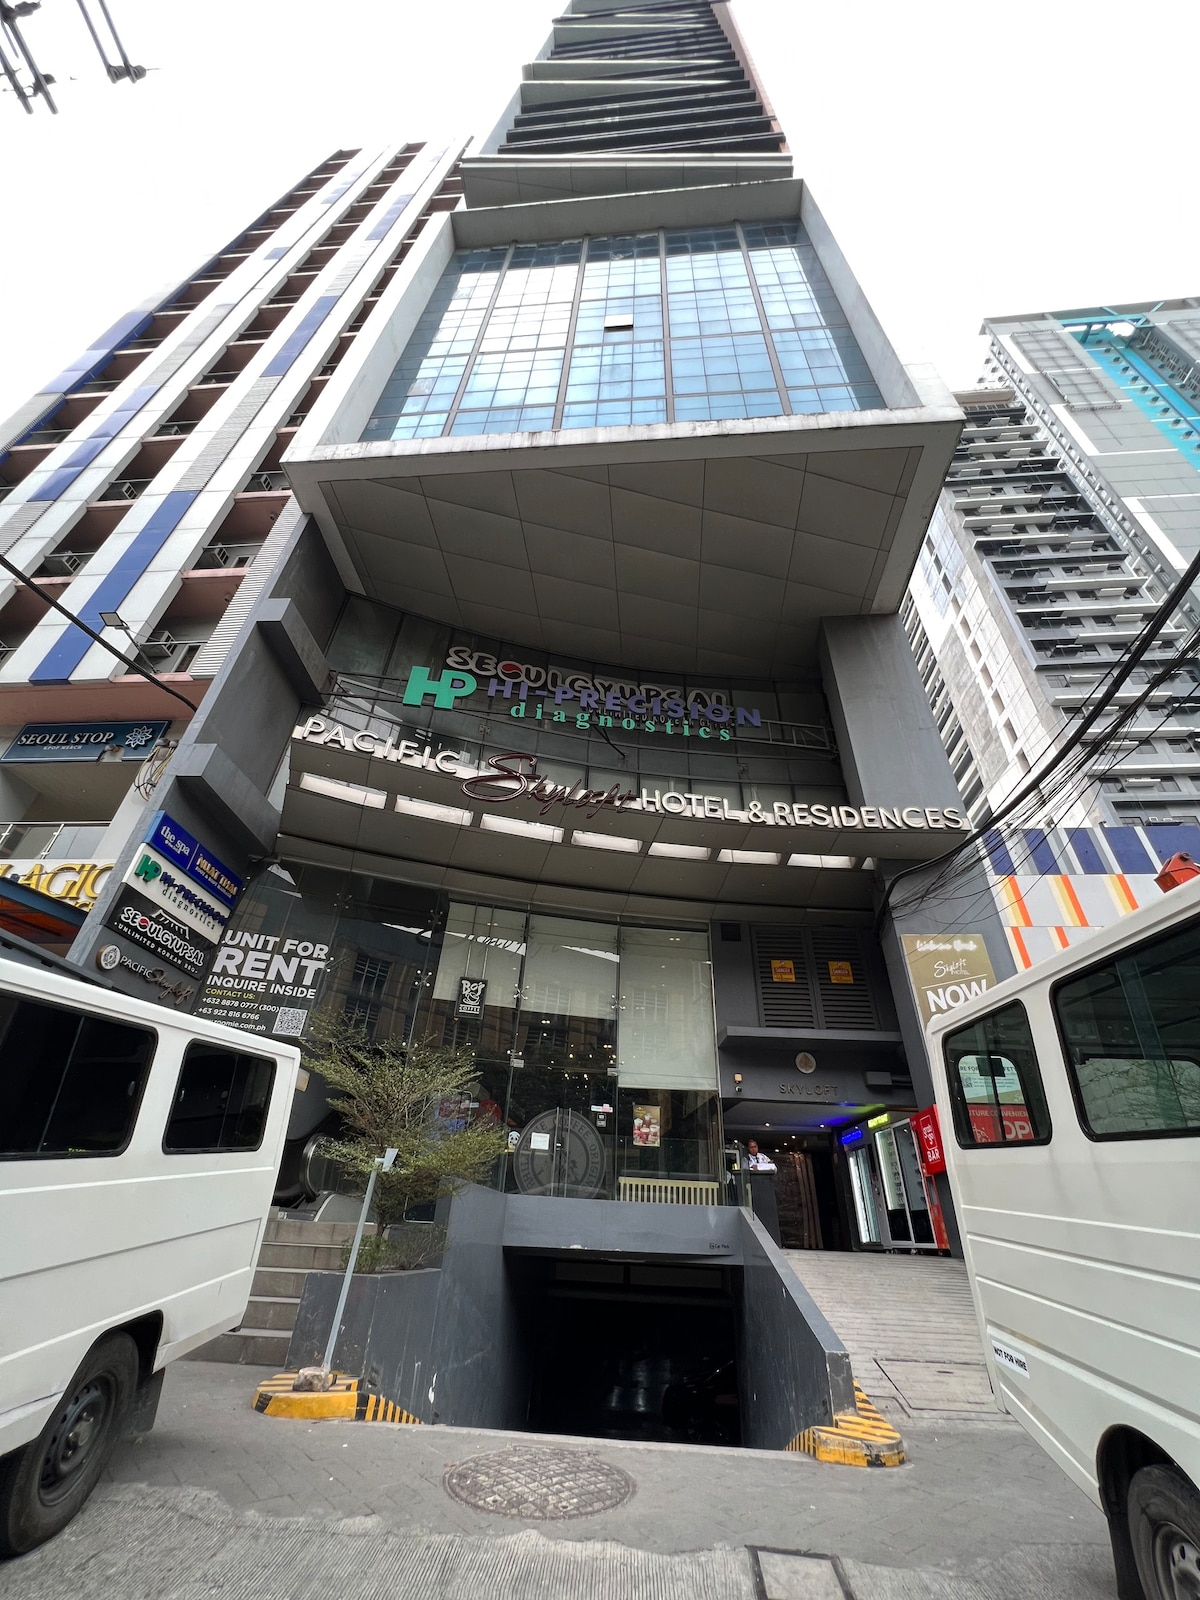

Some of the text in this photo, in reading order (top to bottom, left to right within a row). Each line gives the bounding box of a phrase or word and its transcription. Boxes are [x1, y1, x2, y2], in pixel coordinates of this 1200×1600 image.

[402, 665, 477, 710] HP
[487, 678, 762, 728] HI-PRECISION
[510, 702, 731, 742] diagnostics
[18, 731, 115, 745] SEOUL STOP
[302, 716, 965, 830] PACIFIC Skyloft HOTEL & RESIDENCES
[160, 825, 176, 843] the
[175, 839, 190, 856] spa
[0, 863, 117, 900] AGIC
[162, 887, 216, 930] diagnostics
[118, 923, 156, 949] UNLIMITED
[157, 947, 182, 965] KOREAN
[121, 907, 205, 966] SEOULGYUPSAL
[224, 929, 329, 960] UNIT FOR
[120, 955, 153, 979] PACIFIC
[212, 946, 326, 986] RENT
[205, 987, 256, 1000] CONTACT US:
[206, 974, 317, 999] INQUIRE INSIDE
[926, 979, 987, 1012] NOW
[198, 1007, 260, 1020] +63 922 816 6766
[202, 997, 280, 1013] +632 8878 0777 (300)
[779, 1083, 838, 1096] SKYLOFT
[926, 1148, 941, 1162] BAR
[993, 1345, 1028, 1372] NOT FOR HIRE
